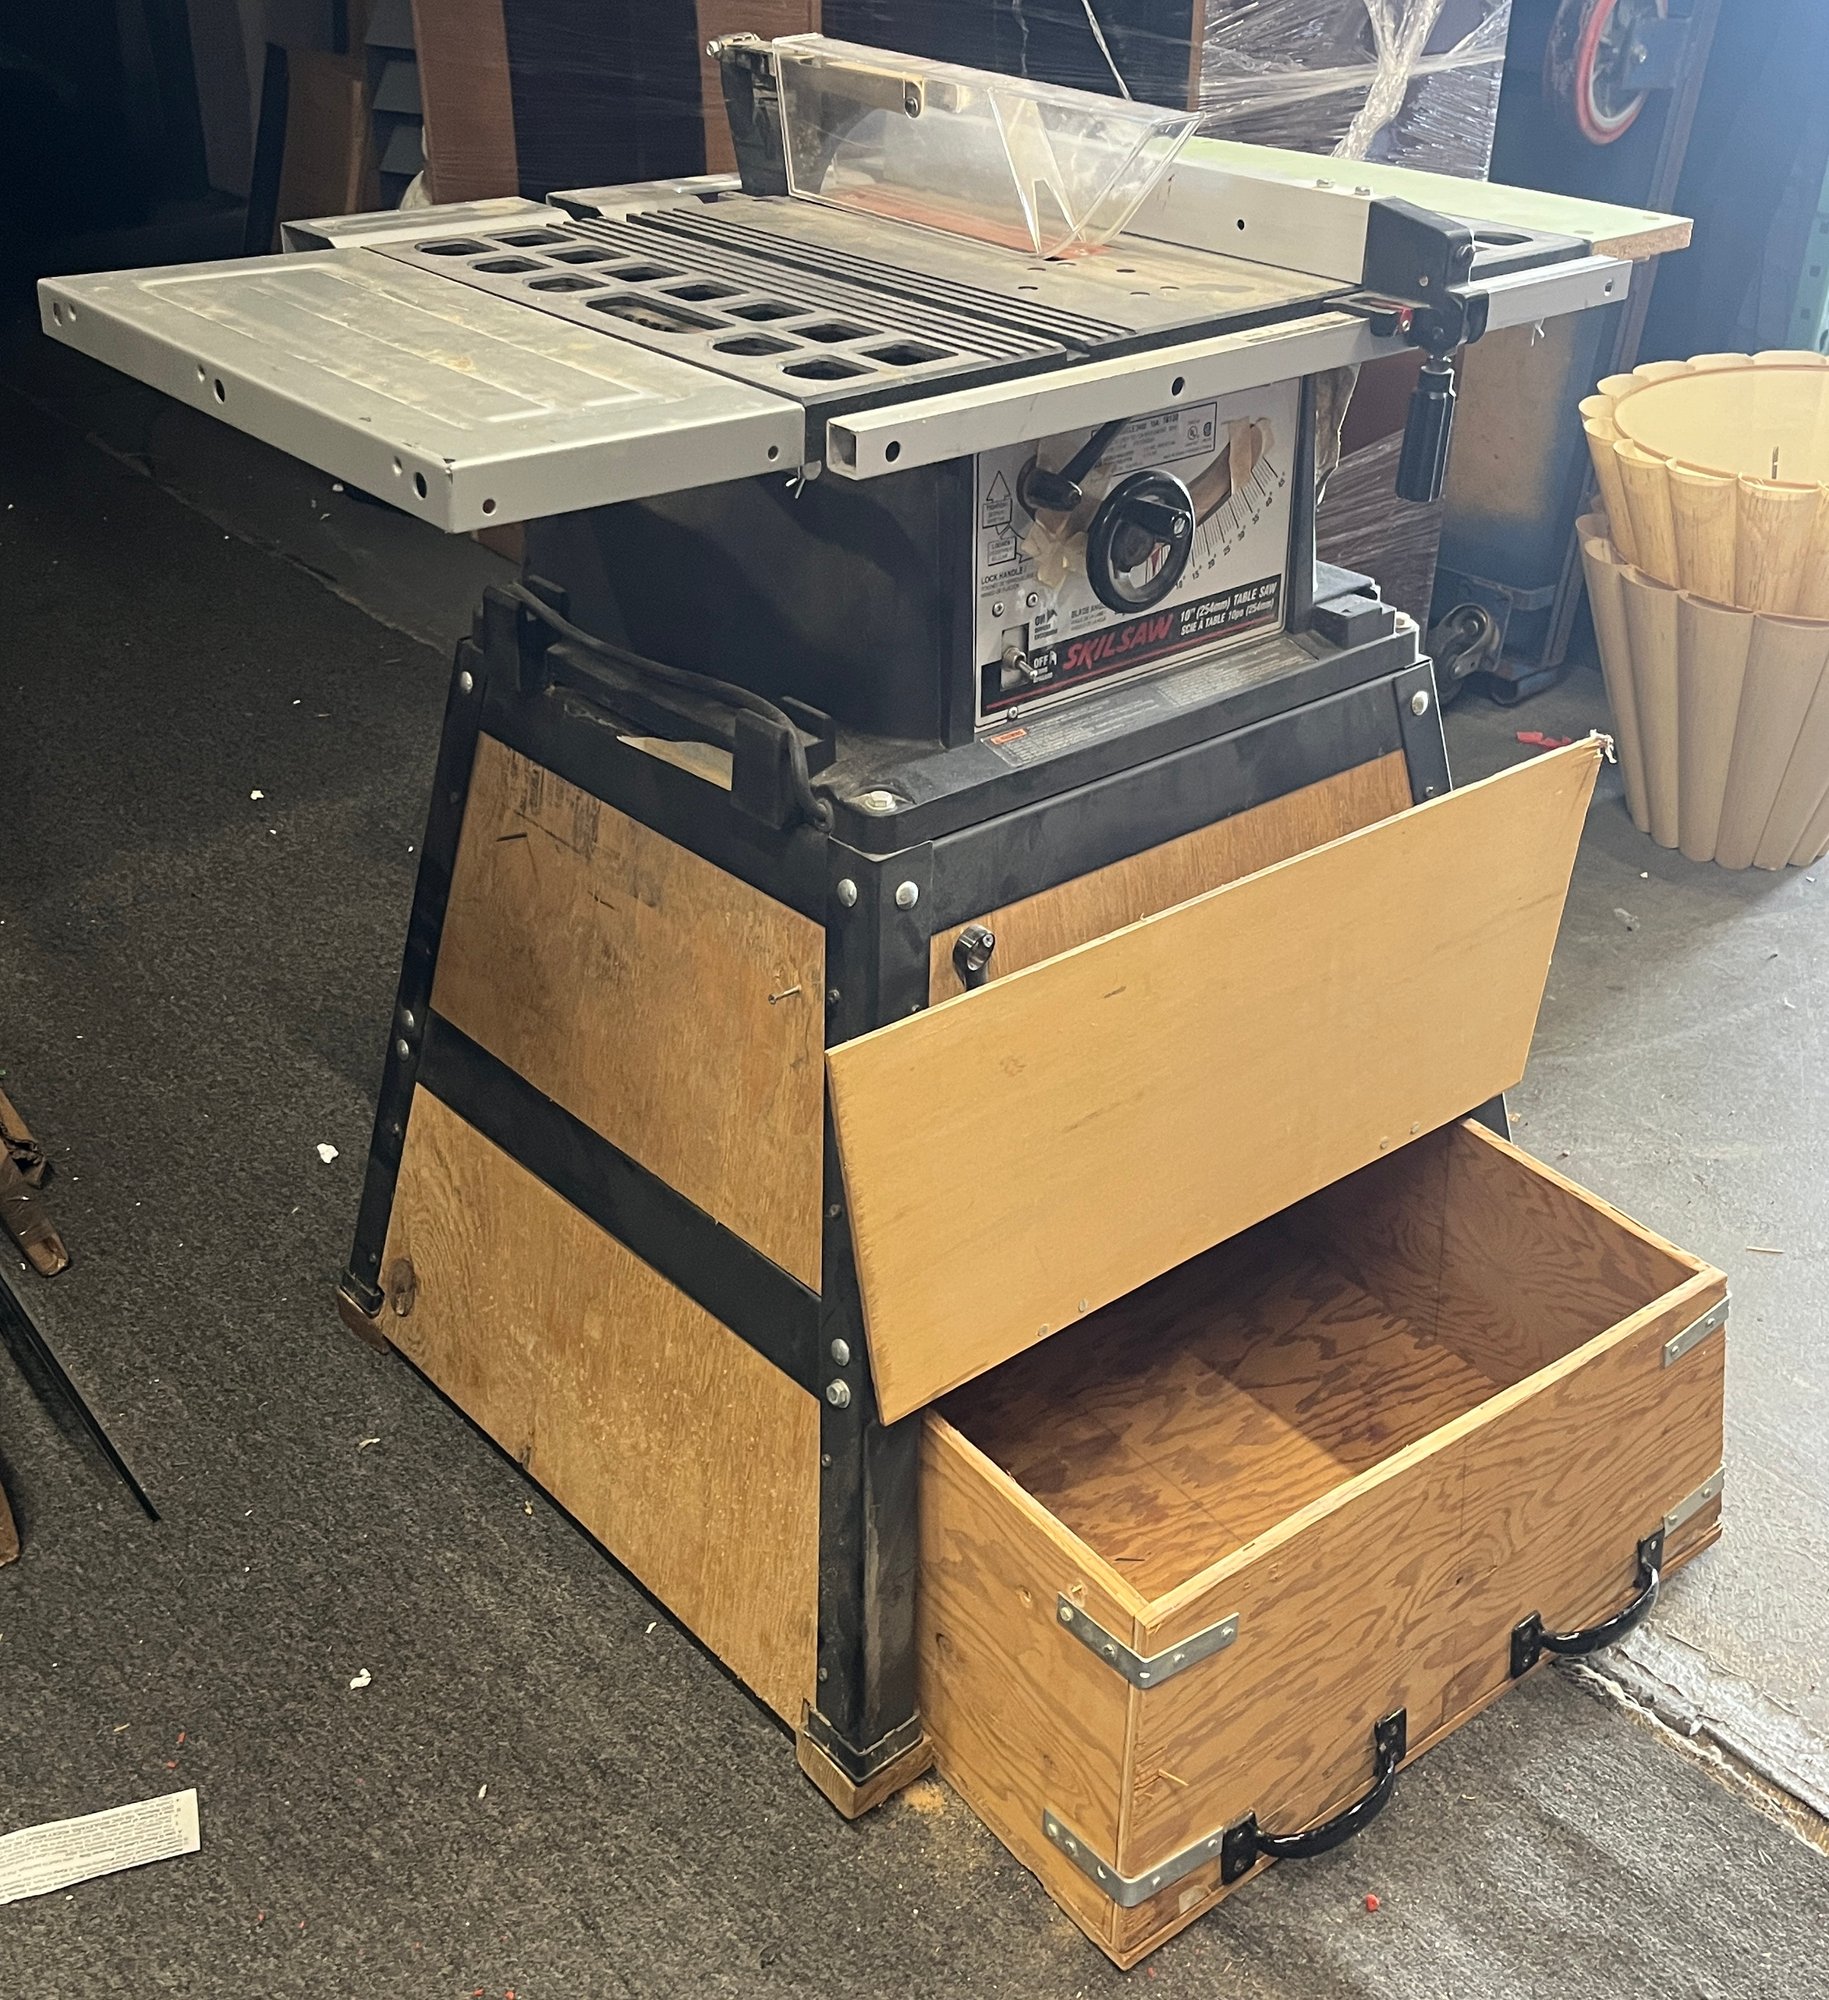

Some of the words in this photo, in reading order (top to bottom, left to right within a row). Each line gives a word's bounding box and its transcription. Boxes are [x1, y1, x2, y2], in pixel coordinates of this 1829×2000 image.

[981, 574, 997, 585] LOCK
[1233, 588, 1258, 606] TABLE
[1259, 582, 1277, 598] SAW
[1181, 621, 1198, 636] SCIE
[1205, 612, 1227, 628] TABLE
[1063, 613, 1174, 669] SKILSAW
[1033, 654, 1049, 669] OFF
